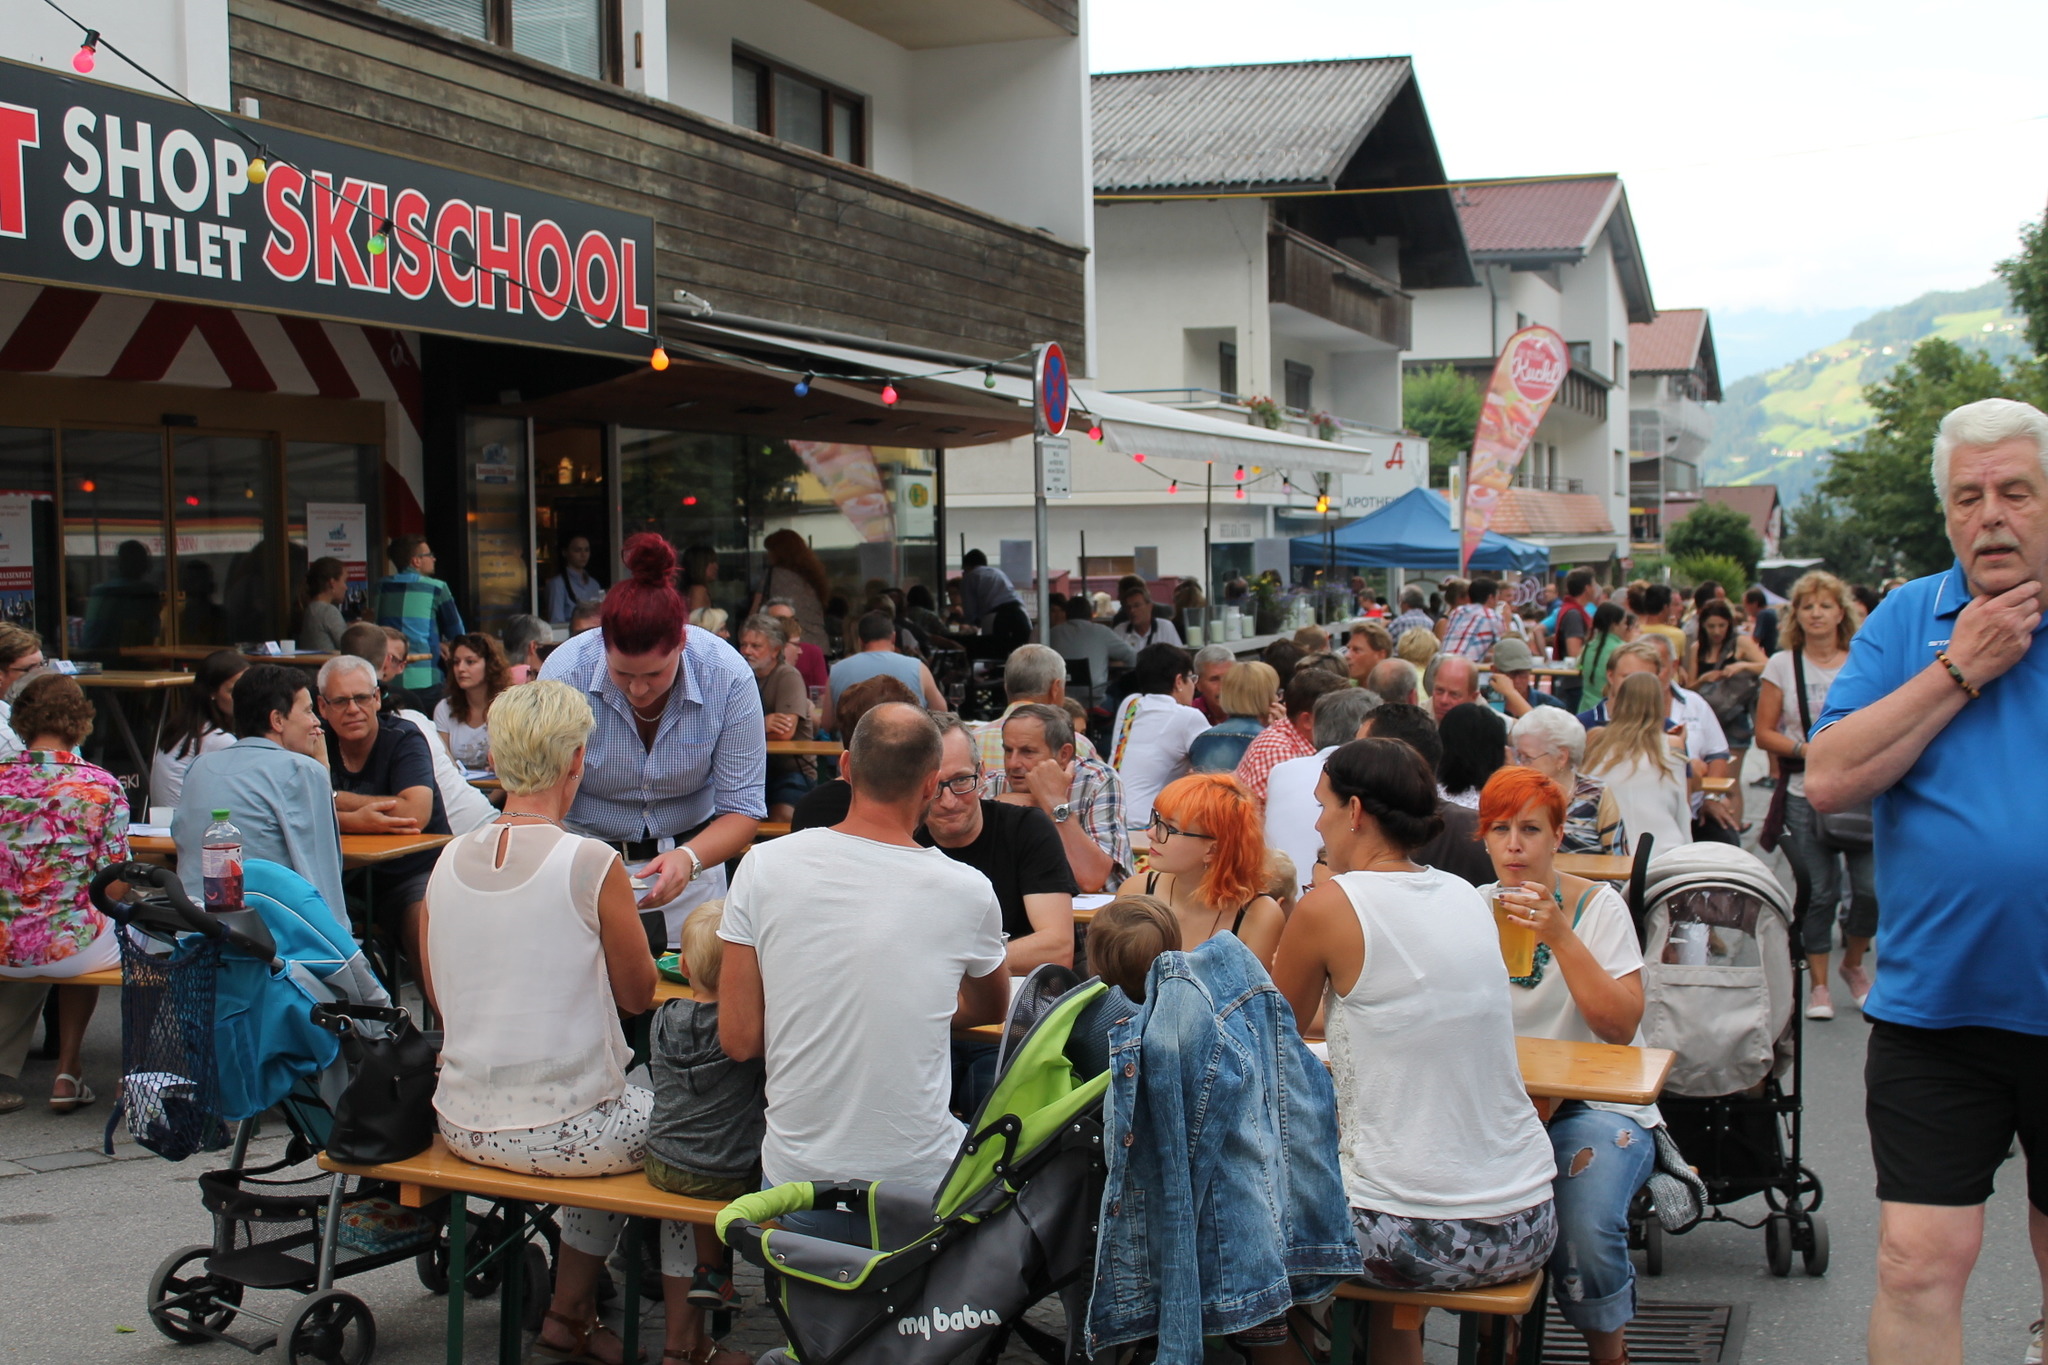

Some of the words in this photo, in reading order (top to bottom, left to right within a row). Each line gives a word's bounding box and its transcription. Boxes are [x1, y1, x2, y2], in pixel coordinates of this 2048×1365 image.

[63, 106, 249, 218] SHOP
[62, 199, 247, 282] OUTLET
[262, 160, 650, 334] SKISCHOOL
